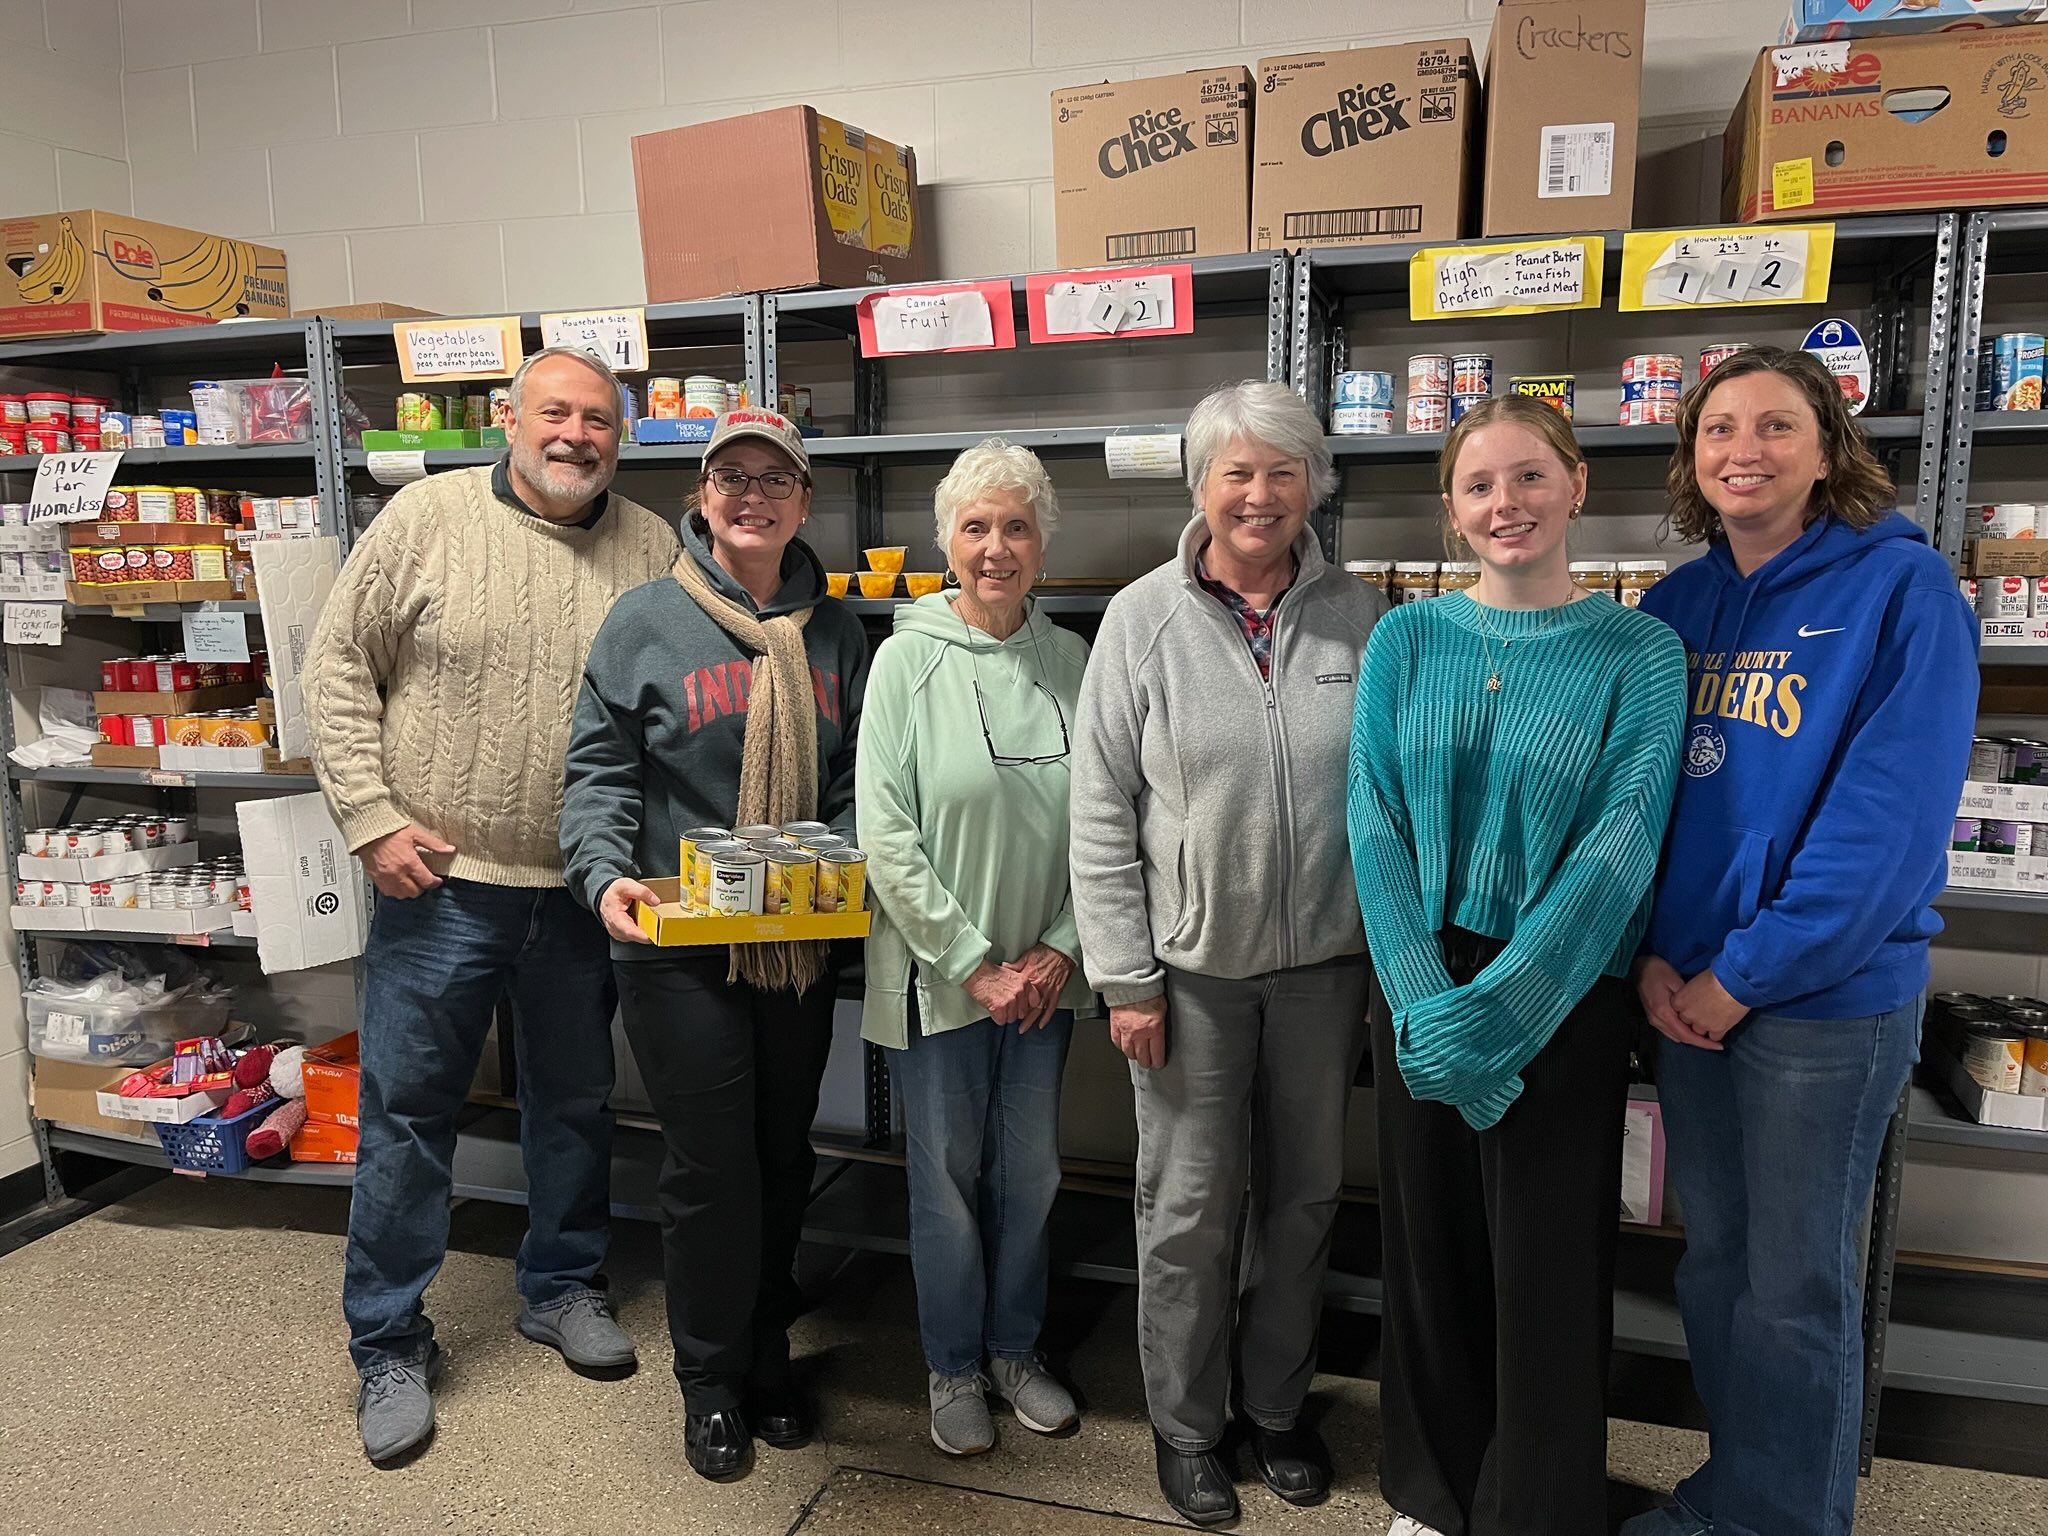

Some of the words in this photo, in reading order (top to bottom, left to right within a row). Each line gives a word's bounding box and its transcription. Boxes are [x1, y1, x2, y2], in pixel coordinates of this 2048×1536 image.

[1516, 15, 1632, 60] Crackers
[1417, 55, 1450, 67] 48794
[1996, 54, 2015, 67] WITH
[1201, 83, 1231, 95] 48794
[1337, 82, 1396, 116] Rice
[1771, 100, 1880, 124] BANANAS
[1129, 107, 1182, 140] Rice
[1301, 100, 1411, 157] Chex
[1098, 122, 1198, 179] Chex
[819, 143, 862, 187] Crispy
[825, 173, 857, 206] Oats
[874, 163, 911, 205] Crispy
[881, 192, 908, 222] Oats
[1681, 244, 1690, 255] 1
[1765, 240, 1780, 251] 4+
[1694, 235, 1734, 243] Household
[114, 240, 153, 265] Dole
[1515, 254, 1551, 266] Peanut
[1552, 250, 1582, 263] Butter
[1440, 262, 1477, 288] High
[1515, 270, 1542, 281] Tuna
[1545, 267, 1570, 278] Fish
[1727, 269, 1737, 289] 1
[1761, 261, 1781, 288] 2
[243, 274, 285, 294] PREMIUM
[1513, 283, 1549, 295] Canned
[1553, 281, 1579, 293] Meat
[1679, 272, 1688, 294] 1
[244, 289, 286, 308] BANANAS
[906, 297, 946, 308] Canned
[1439, 282, 1493, 309] Protein
[1102, 304, 1112, 321] 1
[1133, 300, 1151, 321] 2
[562, 317, 604, 327] Household
[900, 311, 949, 329] Fruit
[409, 330, 485, 350] Vegetables
[446, 351, 467, 361] green
[469, 347, 495, 357] beans
[616, 341, 630, 364] 4
[1826, 350, 1862, 363] Cooked
[416, 361, 433, 370] peas
[470, 359, 500, 368] potatoes
[1826, 362, 1851, 371] Ham
[1518, 382, 1565, 396] SPAM
[676, 422, 699, 433] Happy
[727, 413, 785, 431] INDIANA
[680, 428, 708, 437] Harvest
[40, 458, 98, 476] SAVE
[52, 477, 86, 492] for
[1982, 785, 1997, 794] FRESH
[1998, 786, 2013, 795] THYME
[1986, 855, 2000, 864] FRESH
[2001, 857, 2015, 866] THYME
[720, 893, 738, 902] Corn
[316, 1068, 343, 1078] THAW
[336, 1113, 346, 1124] 10
[334, 1150, 341, 1161] 7
